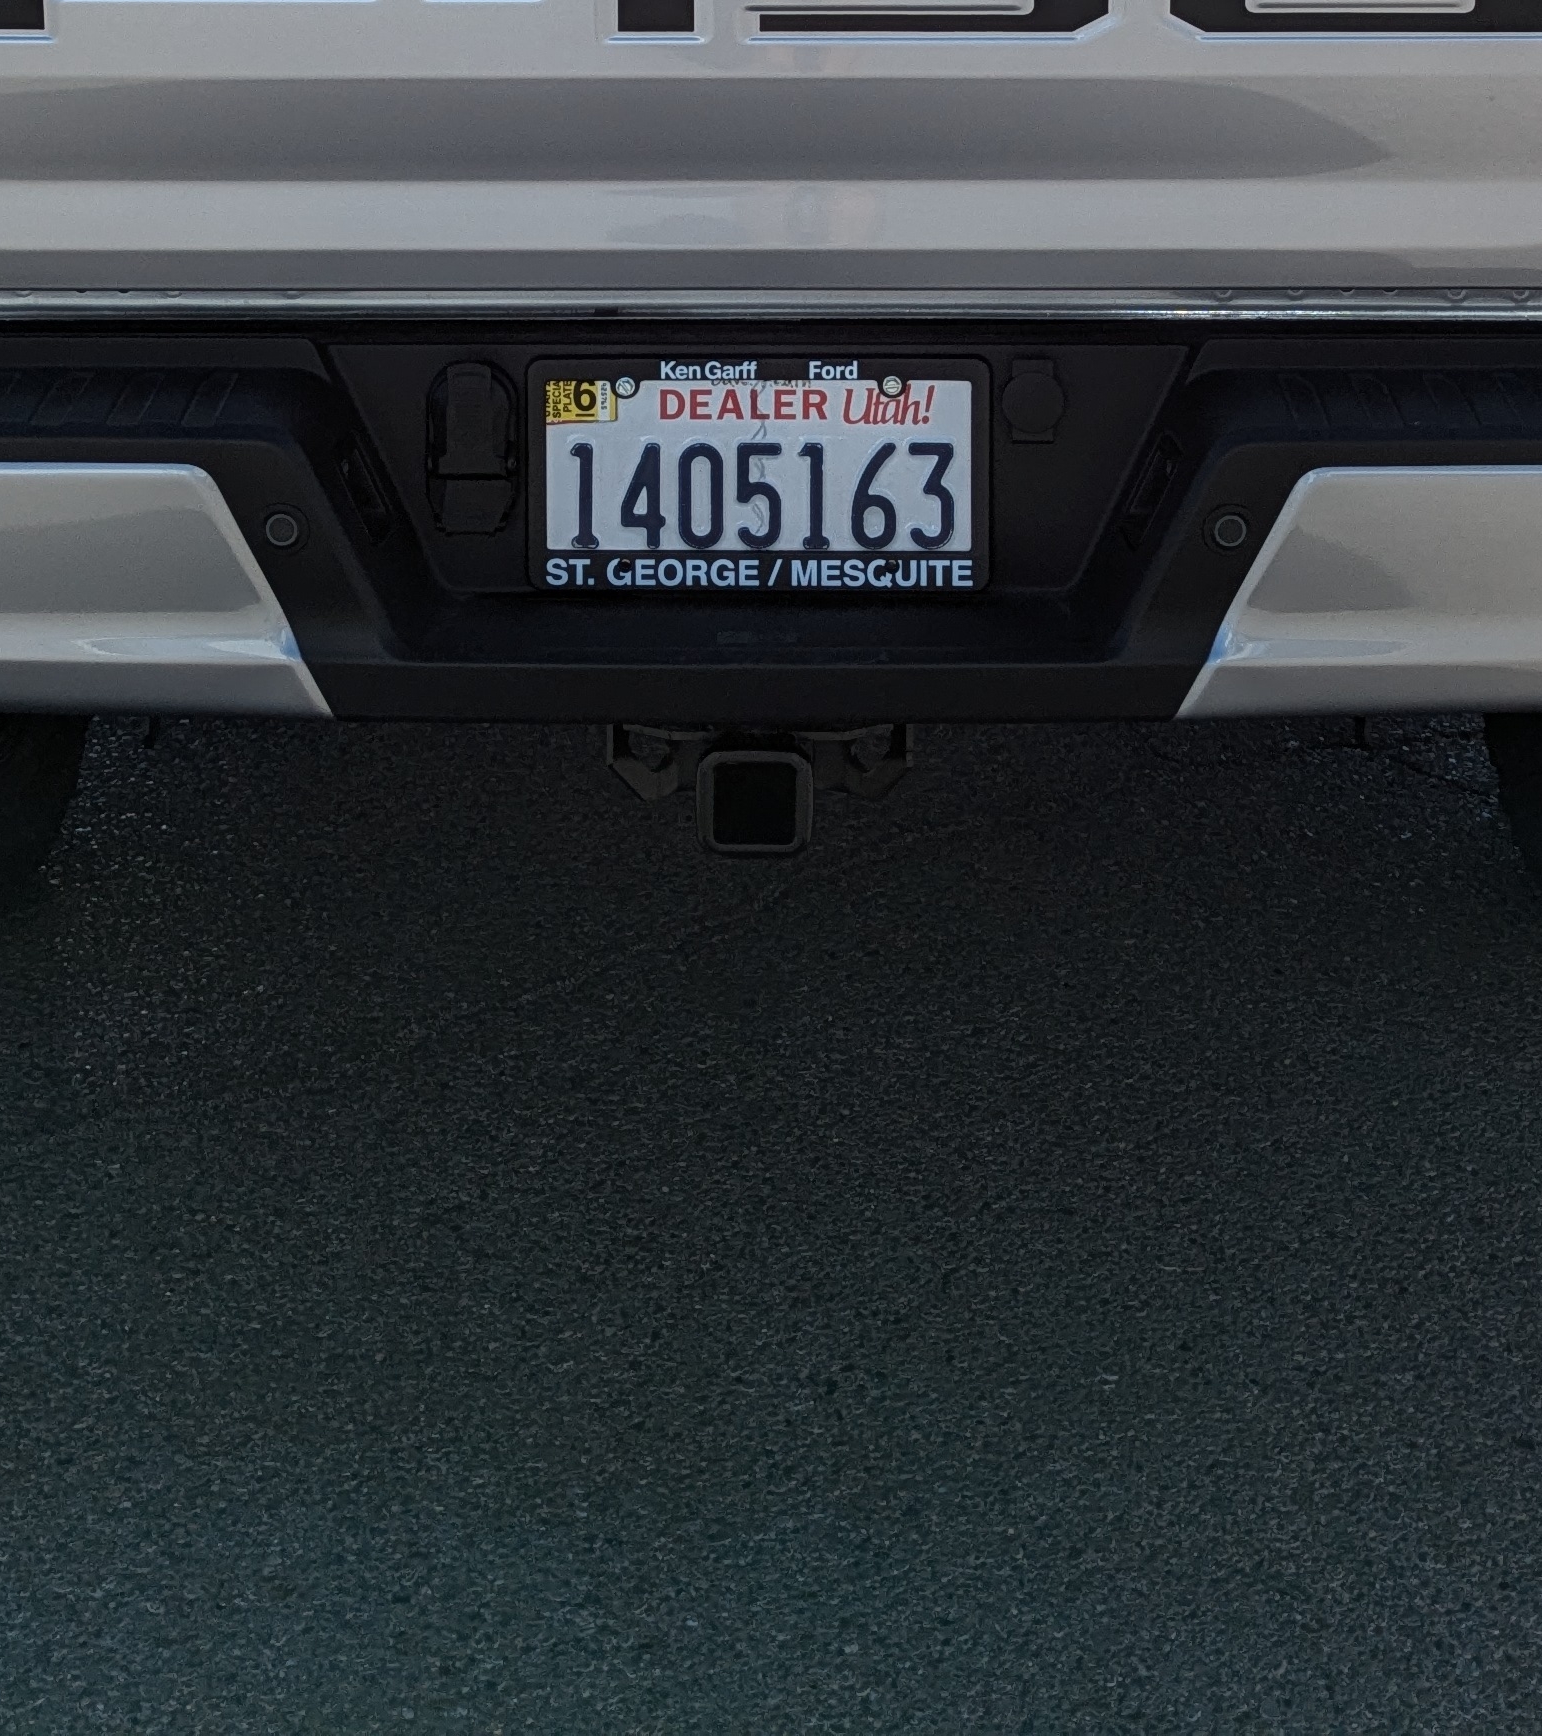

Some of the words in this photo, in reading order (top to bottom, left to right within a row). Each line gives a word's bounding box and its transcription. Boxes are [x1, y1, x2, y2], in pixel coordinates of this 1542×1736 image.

[660, 361, 701, 380] Ken
[705, 361, 757, 380] Garff
[809, 361, 858, 380] Ford
[552, 380, 562, 419] SPECIA
[573, 380, 597, 412] 6
[659, 389, 828, 421] DEALER
[843, 383, 936, 426] Utah!
[569, 442, 955, 550] 1405163
[545, 558, 595, 587] ST.
[606, 558, 760, 587] GEORGE
[790, 558, 973, 588] MESQUITE
